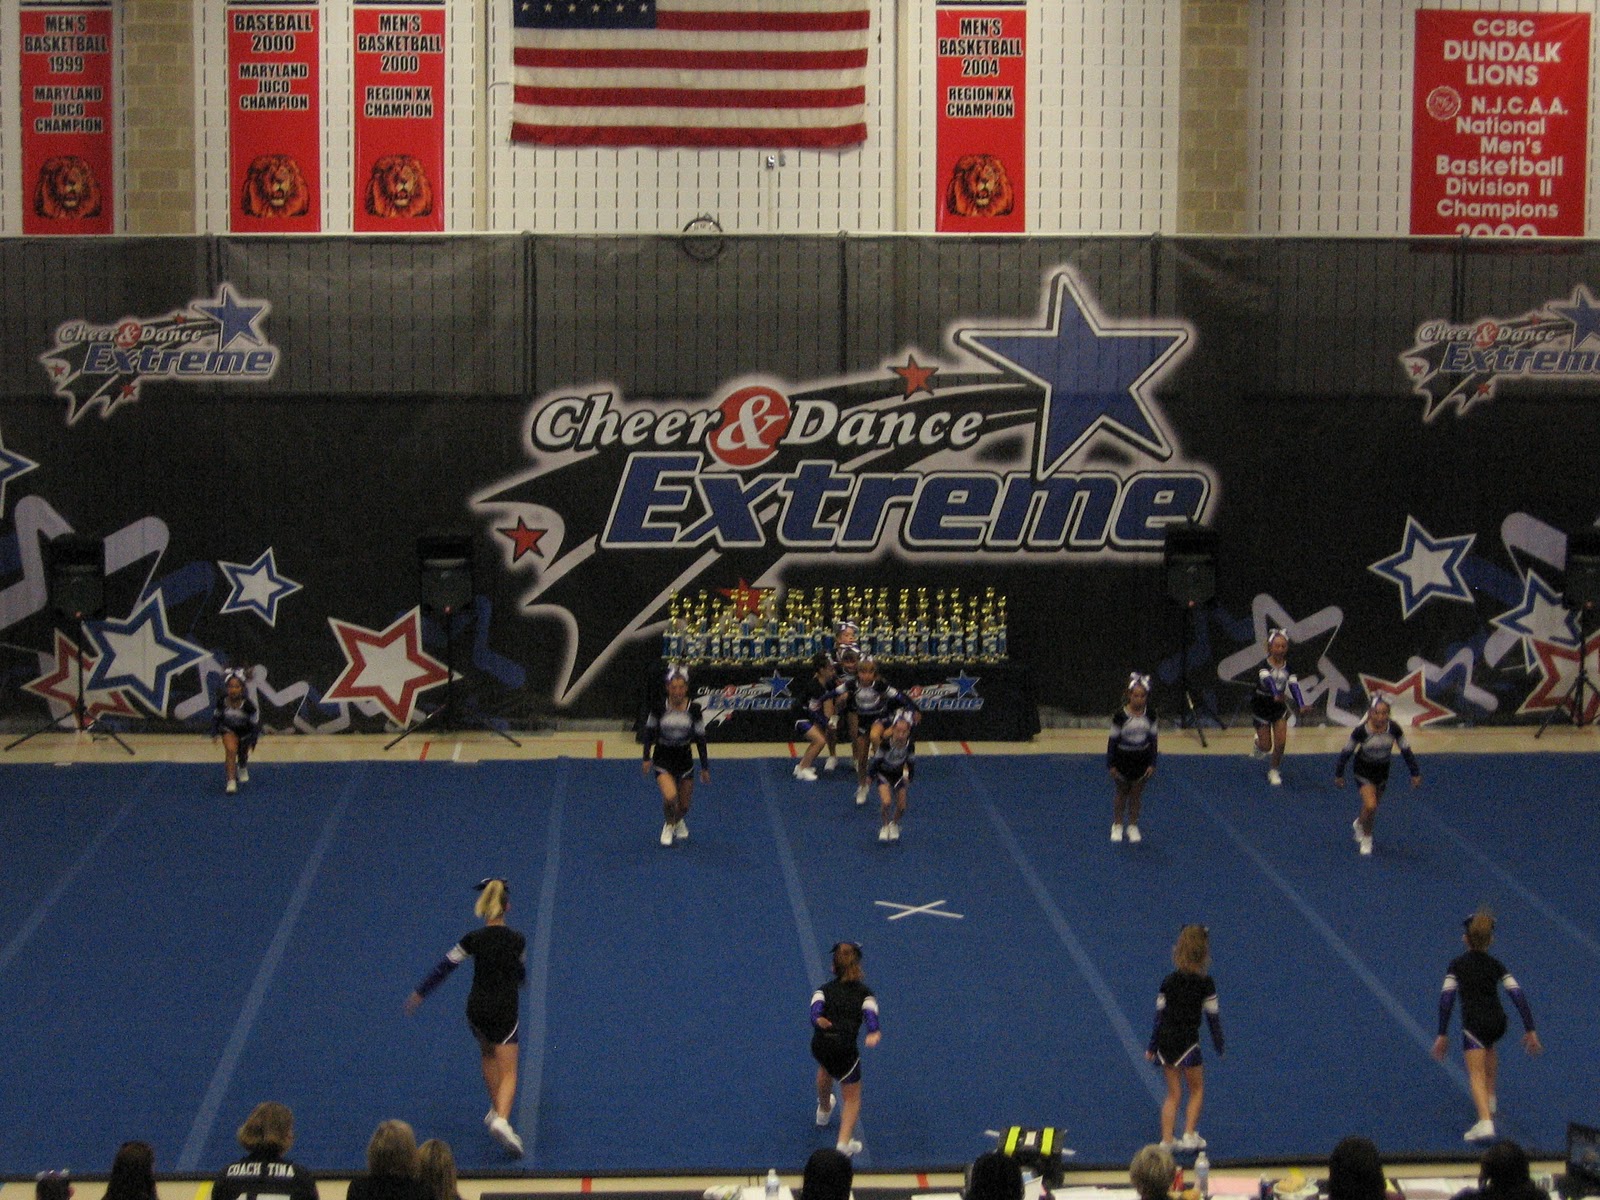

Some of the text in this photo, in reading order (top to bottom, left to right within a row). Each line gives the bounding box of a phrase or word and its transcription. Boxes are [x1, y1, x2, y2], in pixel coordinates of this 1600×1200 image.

[44, 15, 87, 33] MEN'S
[234, 14, 313, 32] BASEBALL
[378, 14, 421, 32] MEN'S
[960, 18, 1002, 36] MEN'S
[1472, 18, 1535, 37] CCBC
[24, 35, 108, 52] BASKETBALL
[252, 35, 296, 52] 2000
[357, 35, 443, 52] BASKETBALL
[939, 38, 1023, 56] BASKETBALL
[1443, 40, 1562, 63] DUNDALK
[49, 56, 84, 73] 1999
[239, 63, 309, 79] MARYLAND
[380, 55, 419, 73] 2000
[961, 59, 999, 76] 2004
[1465, 64, 1539, 86] LIONS
[33, 86, 103, 102] MARYLAND
[257, 79, 291, 94] JUCO
[366, 86, 432, 101] REGION XX
[948, 86, 1013, 101] REGION XX
[52, 103, 85, 117] JUCO
[239, 95, 309, 110] CHAMPION
[364, 103, 434, 118] CHAMPION
[946, 103, 1014, 118] CHAMPION
[1470, 96, 1569, 115] N.J.C.A.A.
[34, 118, 104, 133] CHAMPION
[1455, 116, 1547, 136] National
[1479, 136, 1543, 155] Men's
[1435, 154, 1565, 177] Basketball
[1445, 177, 1530, 196] Division
[1436, 199, 1559, 221] Champions
[59, 323, 120, 343] Cheer
[140, 326, 202, 342] Dance
[1419, 324, 1476, 342] Cheer
[1497, 327, 1555, 342] Dance
[82, 343, 276, 376] Extreme
[1438, 342, 1600, 374] Extrem
[533, 392, 722, 448] Cheer
[780, 399, 985, 446] Dance
[601, 451, 1211, 549] Extreme
[227, 1163, 295, 1177] COACH TINA
